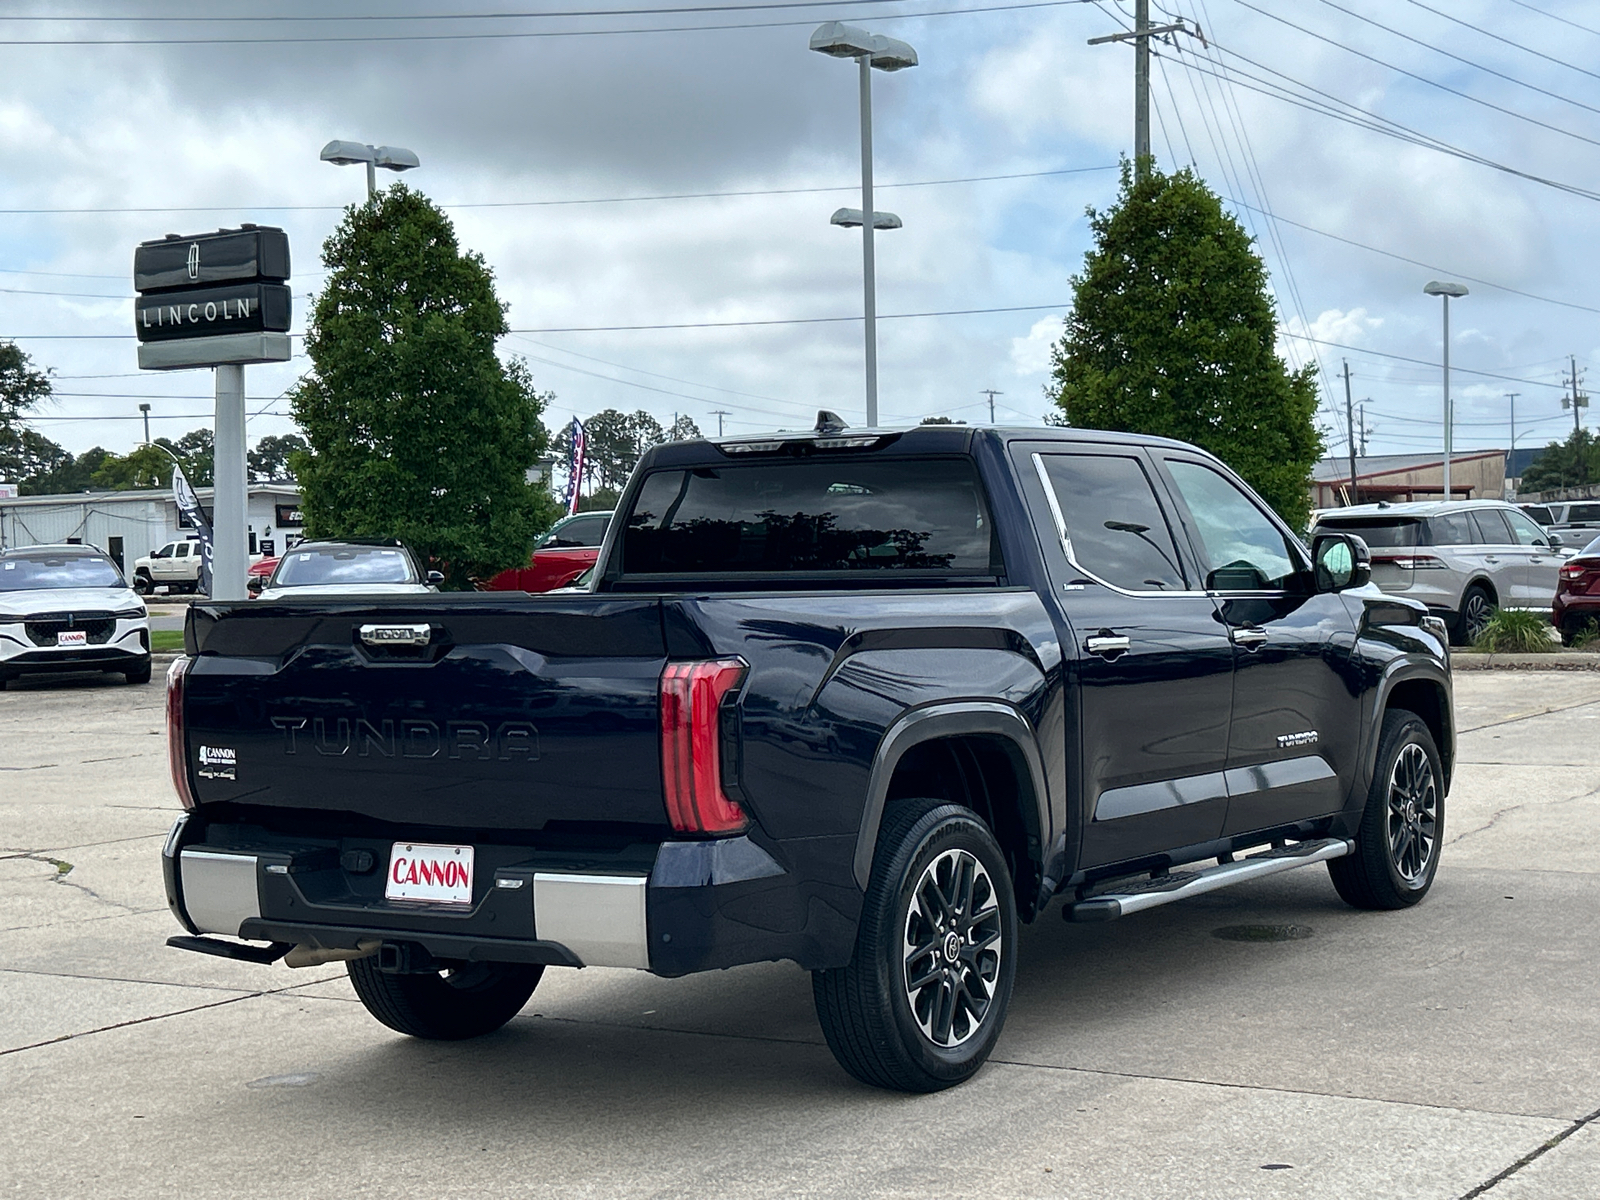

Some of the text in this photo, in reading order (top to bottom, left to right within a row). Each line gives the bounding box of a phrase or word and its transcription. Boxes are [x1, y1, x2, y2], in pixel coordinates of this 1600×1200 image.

[142, 298, 250, 328] LINCOLN
[59, 634, 85, 642] CANNON
[377, 629, 412, 639] TOYOTA
[270, 716, 540, 761] TUNDRA
[1277, 730, 1319, 748] TUNDRA
[206, 747, 236, 759] CANNON
[392, 857, 470, 888] CANNON
